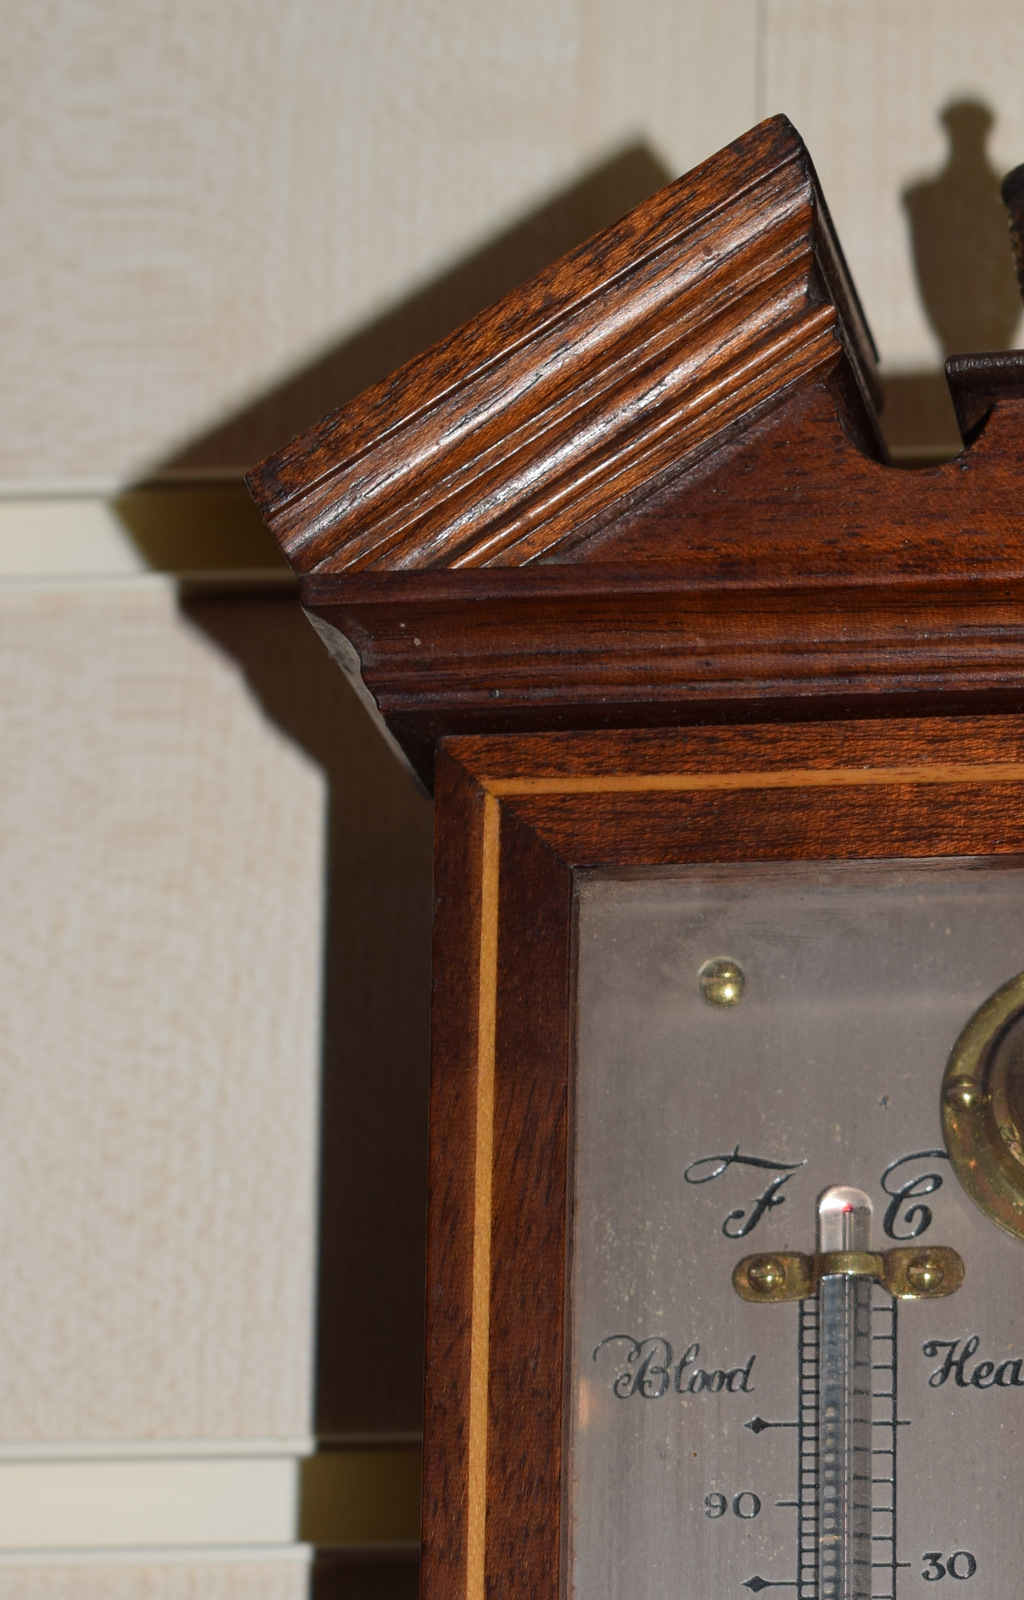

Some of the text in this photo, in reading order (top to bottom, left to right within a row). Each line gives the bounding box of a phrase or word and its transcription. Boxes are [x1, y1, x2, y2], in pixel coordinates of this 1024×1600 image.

[684, 1145, 809, 1239] F
[592, 1334, 756, 1400] Blood
[704, 1491, 762, 1520] 90
[921, 1551, 977, 1581] 30
